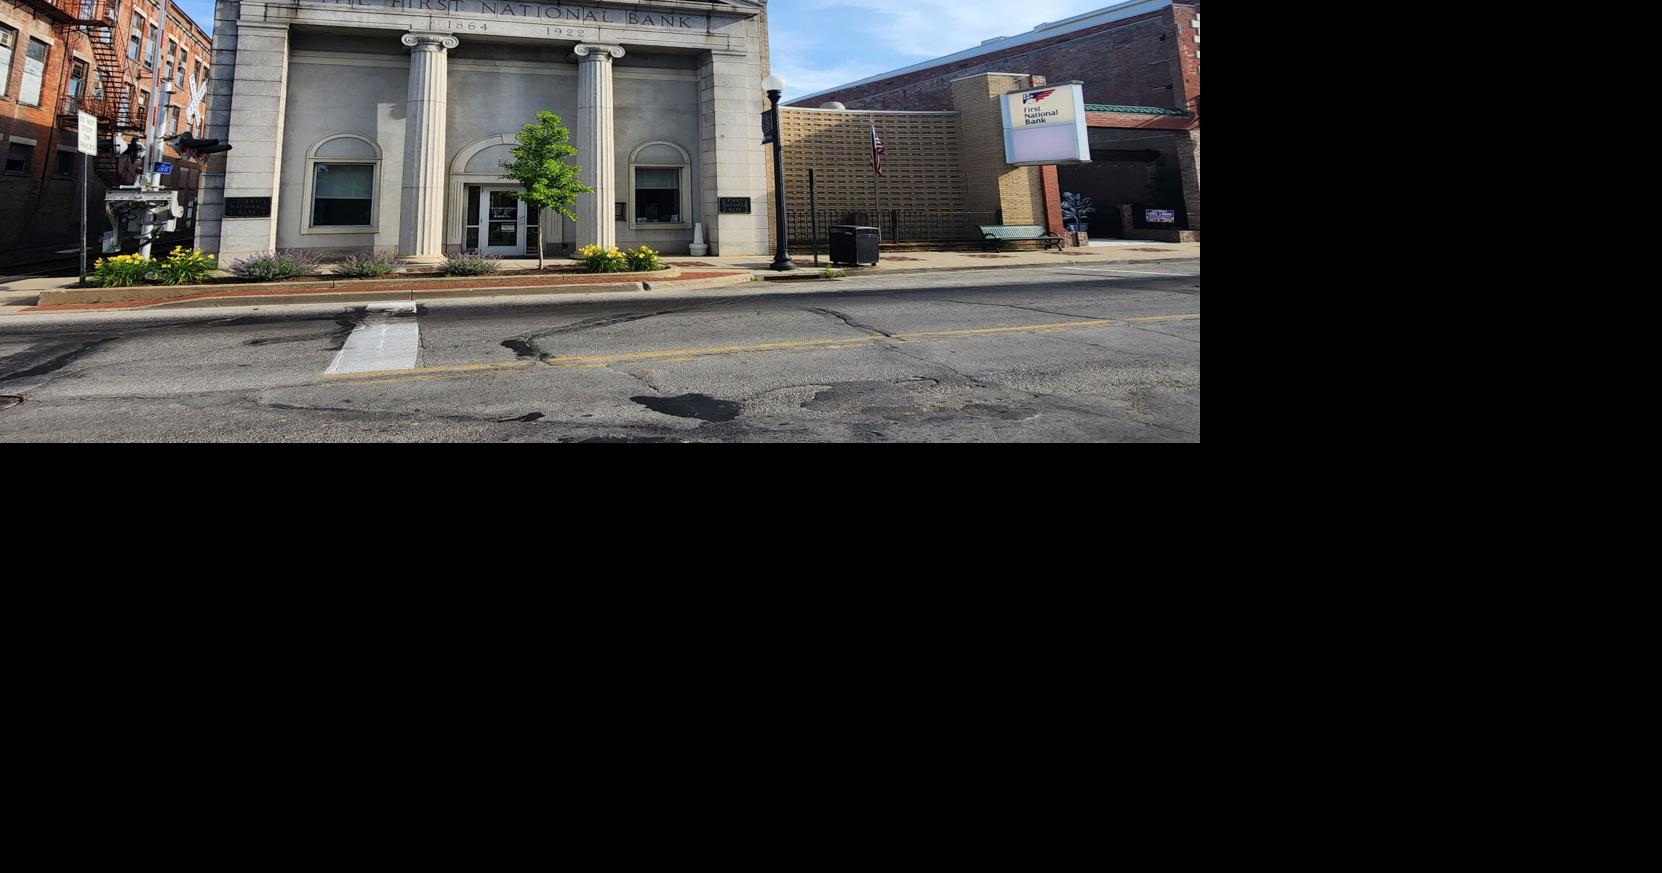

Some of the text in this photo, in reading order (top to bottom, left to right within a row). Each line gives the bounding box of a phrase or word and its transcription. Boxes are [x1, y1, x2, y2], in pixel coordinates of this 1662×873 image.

[391, 0, 693, 28] FIRST NATIONAL BANK
[448, 21, 488, 31] 1864
[546, 27, 584, 37] 1922
[1024, 109, 1059, 119] National
